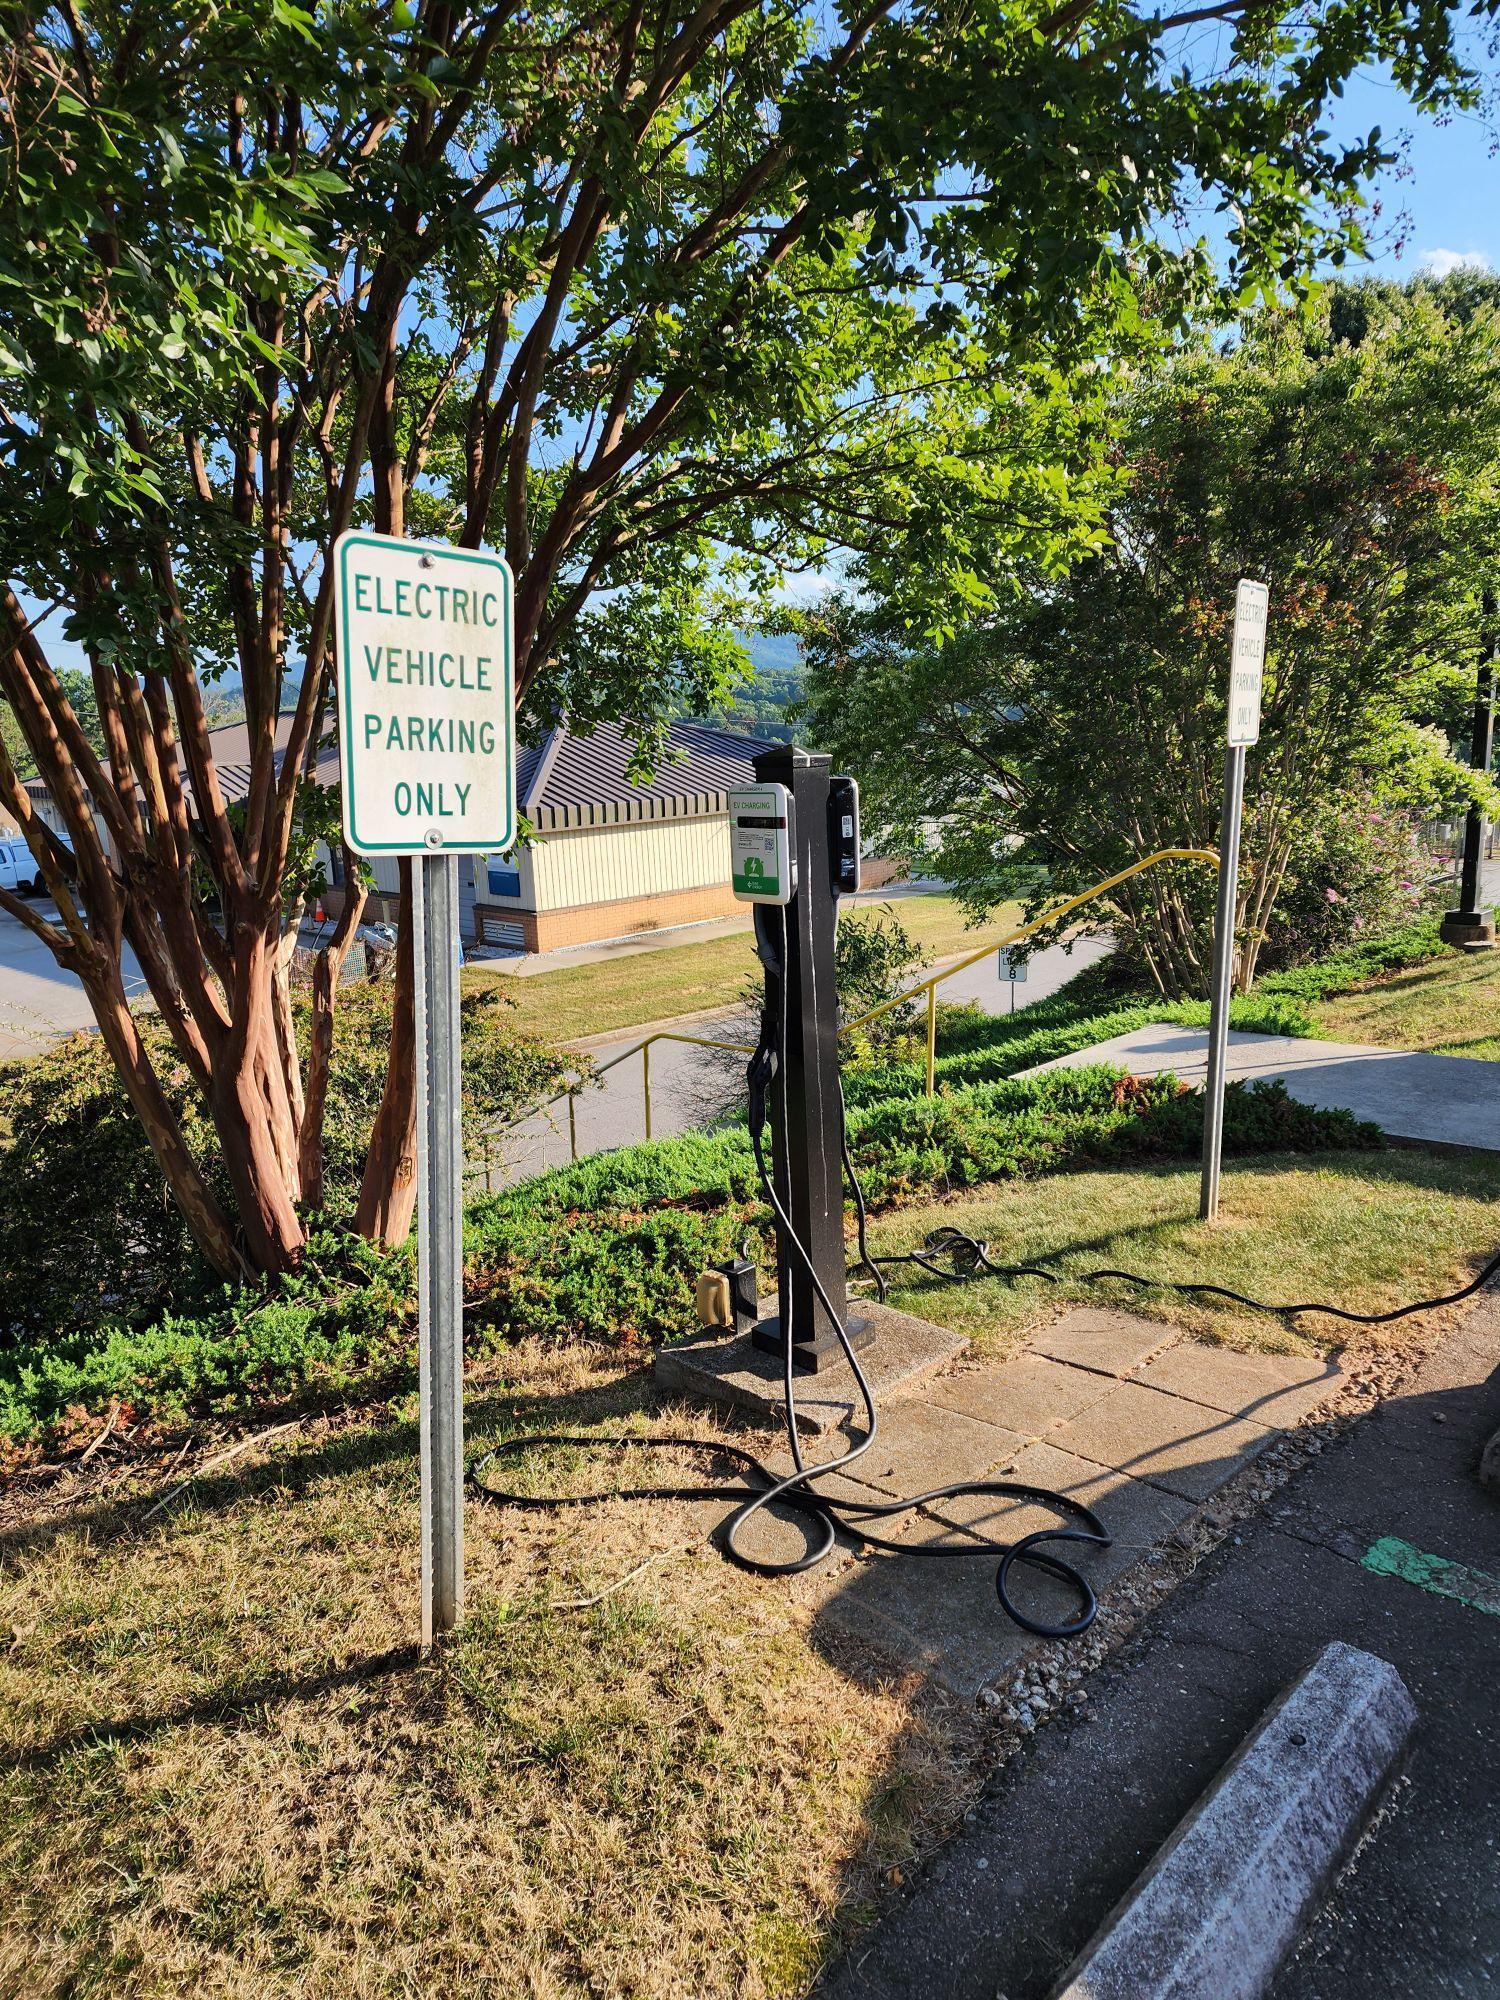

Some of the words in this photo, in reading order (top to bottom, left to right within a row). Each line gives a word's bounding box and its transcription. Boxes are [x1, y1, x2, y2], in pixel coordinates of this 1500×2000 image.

[355, 574, 498, 627] ELECTRIC
[1239, 601, 1265, 624] ELECTRIC
[1238, 637, 1261, 658] VEHICLE
[364, 645, 492, 691] VEHICLE
[1235, 672, 1259, 692] PARKING
[1237, 707, 1253, 726] ONLY
[364, 714, 495, 755] PARKING
[394, 781, 472, 817] ONLY
[733, 801, 741, 809] EV
[1009, 969, 1017, 979] 8
